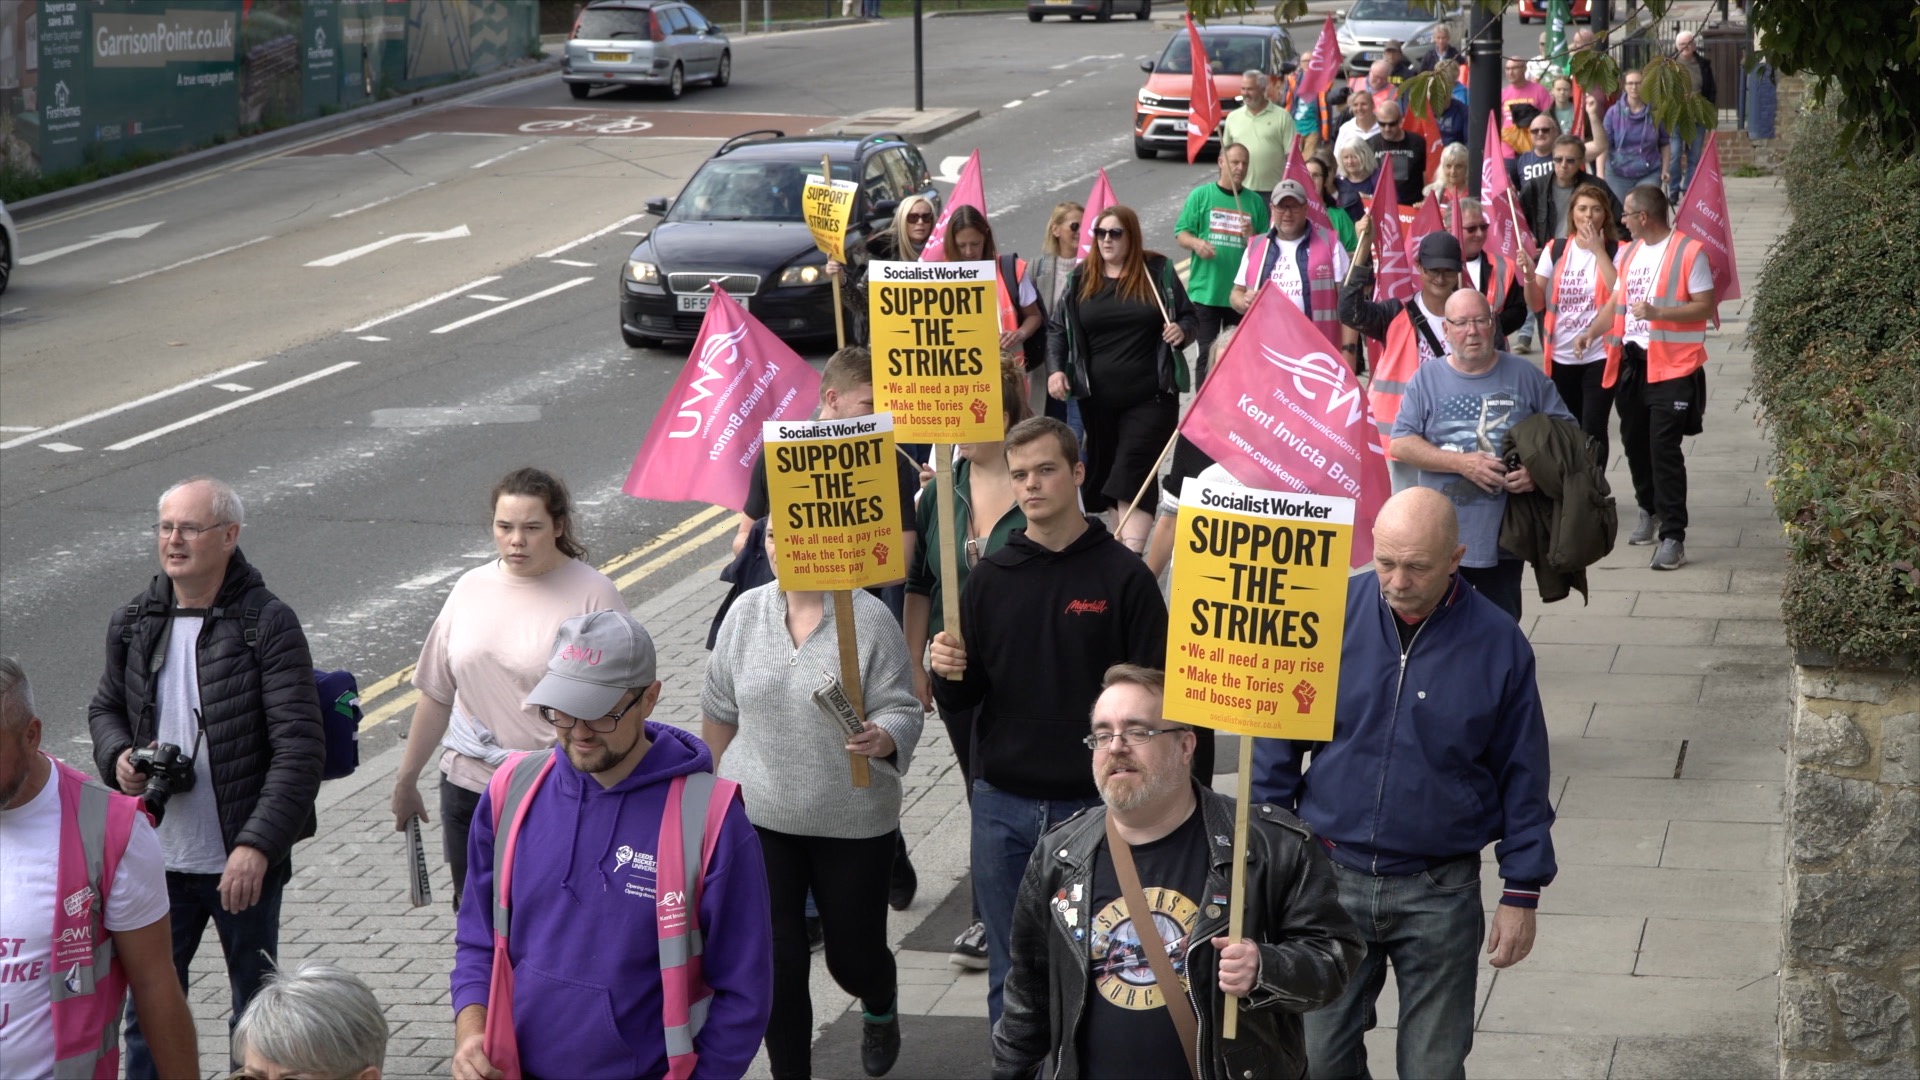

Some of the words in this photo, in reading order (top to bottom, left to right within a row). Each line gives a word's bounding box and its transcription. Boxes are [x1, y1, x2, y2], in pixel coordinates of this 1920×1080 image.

[96, 19, 232, 57] GarrisonPoint.co.uk
[807, 187, 849, 205] SUPPORT
[817, 202, 833, 216] THE
[1695, 200, 1720, 222] Kent
[808, 215, 840, 233] STRIKES
[880, 286, 985, 316] SUPPORT
[1560, 305, 1584, 313] OOKS
[911, 318, 955, 346] THE
[888, 347, 983, 377] STRIKES
[889, 382, 903, 394] We
[905, 382, 917, 394] all
[920, 382, 942, 394] need
[944, 385, 950, 394] a
[953, 384, 969, 396] pay
[972, 381, 991, 393] rise
[890, 400, 914, 411] Make
[917, 400, 932, 411] the
[935, 400, 964, 411] Tories
[892, 414, 908, 425] and
[910, 414, 942, 425] bosses
[945, 416, 961, 427] pay
[1237, 393, 1275, 430] Kent
[1273, 421, 1327, 469] Invicta
[1273, 388, 1289, 405] The
[1288, 401, 1356, 456] communications
[776, 438, 884, 473] SUPPORT
[810, 472, 856, 500] THE
[788, 495, 884, 530] STRIKES
[790, 534, 805, 545] We
[808, 534, 819, 545] all
[822, 533, 845, 544] need
[847, 535, 853, 543] a
[856, 530, 871, 544] pay
[874, 527, 891, 538] rise
[1189, 515, 1337, 567] SUPPORT
[792, 550, 817, 561] Make
[820, 549, 834, 561] the
[837, 547, 866, 560] Tories
[794, 563, 810, 574] and
[813, 561, 846, 573] bosses
[848, 561, 864, 574] pay
[1229, 563, 1288, 605] THE
[1190, 598, 1320, 649] STRIKES
[557, 644, 603, 666] CWU
[1188, 643, 1205, 660] We
[1209, 647, 1224, 662] all
[1228, 651, 1258, 669] need
[1262, 658, 1269, 671] a
[1274, 658, 1296, 675] pay
[1300, 657, 1325, 673] rise
[1186, 665, 1218, 685] Make
[1222, 672, 1241, 689] the
[1246, 675, 1284, 694] Tories
[827, 685, 850, 712] TORIES
[1185, 685, 1207, 702] and
[1210, 688, 1252, 710] bosses
[1256, 698, 1278, 715] pay
[841, 708, 855, 720] IN
[1210, 713, 1282, 730] socialistworker.co.uk
[846, 716, 865, 735] COUR
[635, 851, 654, 861] LEEDS
[624, 888, 643, 897] Opening
[626, 882, 644, 891] Opening
[656, 890, 686, 907] CW
